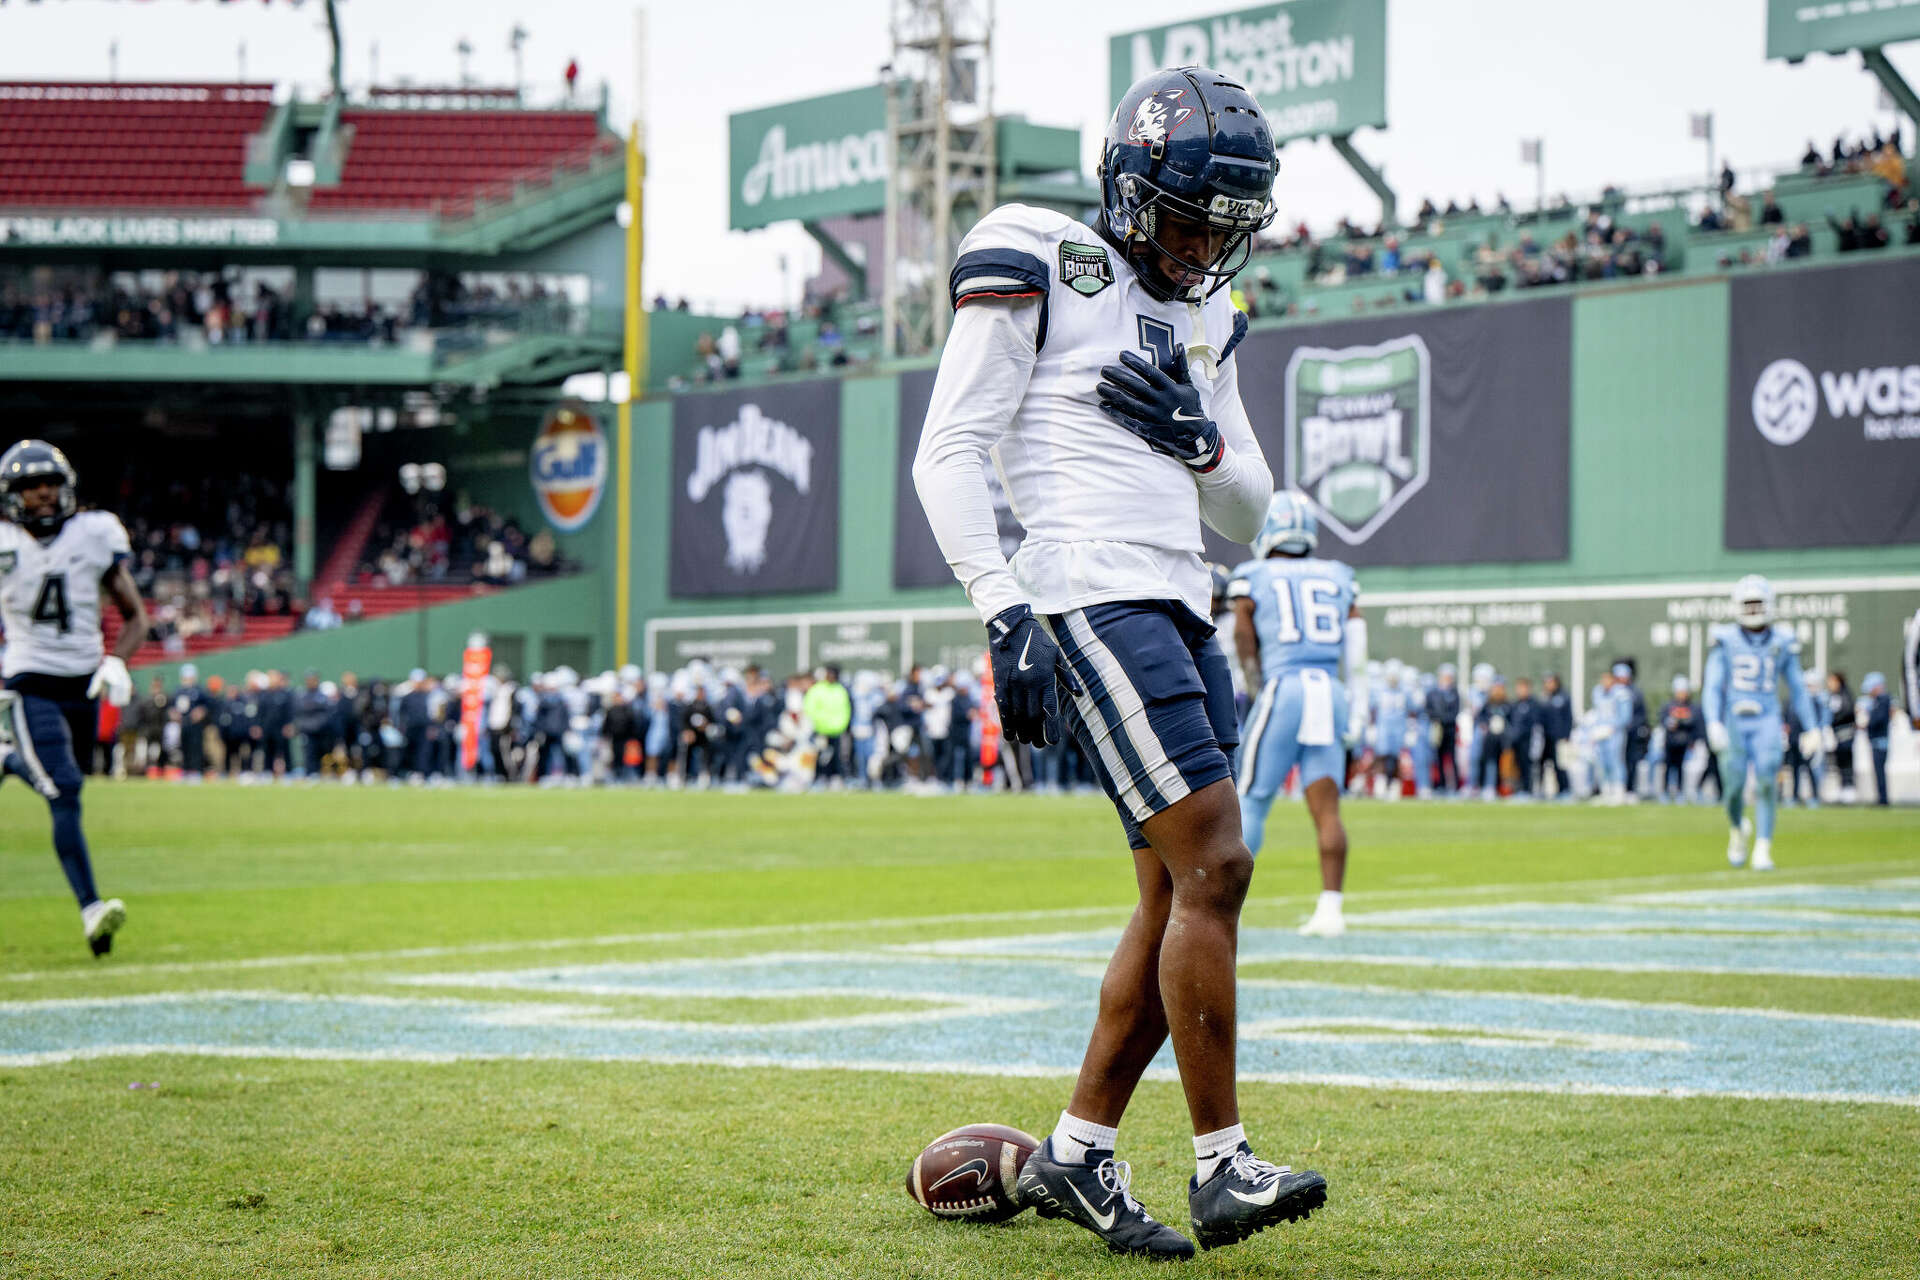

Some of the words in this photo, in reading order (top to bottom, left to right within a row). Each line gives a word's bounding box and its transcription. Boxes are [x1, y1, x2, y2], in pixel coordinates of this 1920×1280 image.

[29, 217, 107, 244] BLACK
[110, 217, 180, 244] LIVES
[183, 217, 279, 244] MATTER
[1064, 260, 1111, 281] BOWL
[1070, 254, 1101, 263] FENWAY
[1301, 409, 1412, 487] BOWL
[30, 572, 73, 634] 4
[1271, 577, 1343, 644] 16
[1731, 654, 1776, 693] 21
